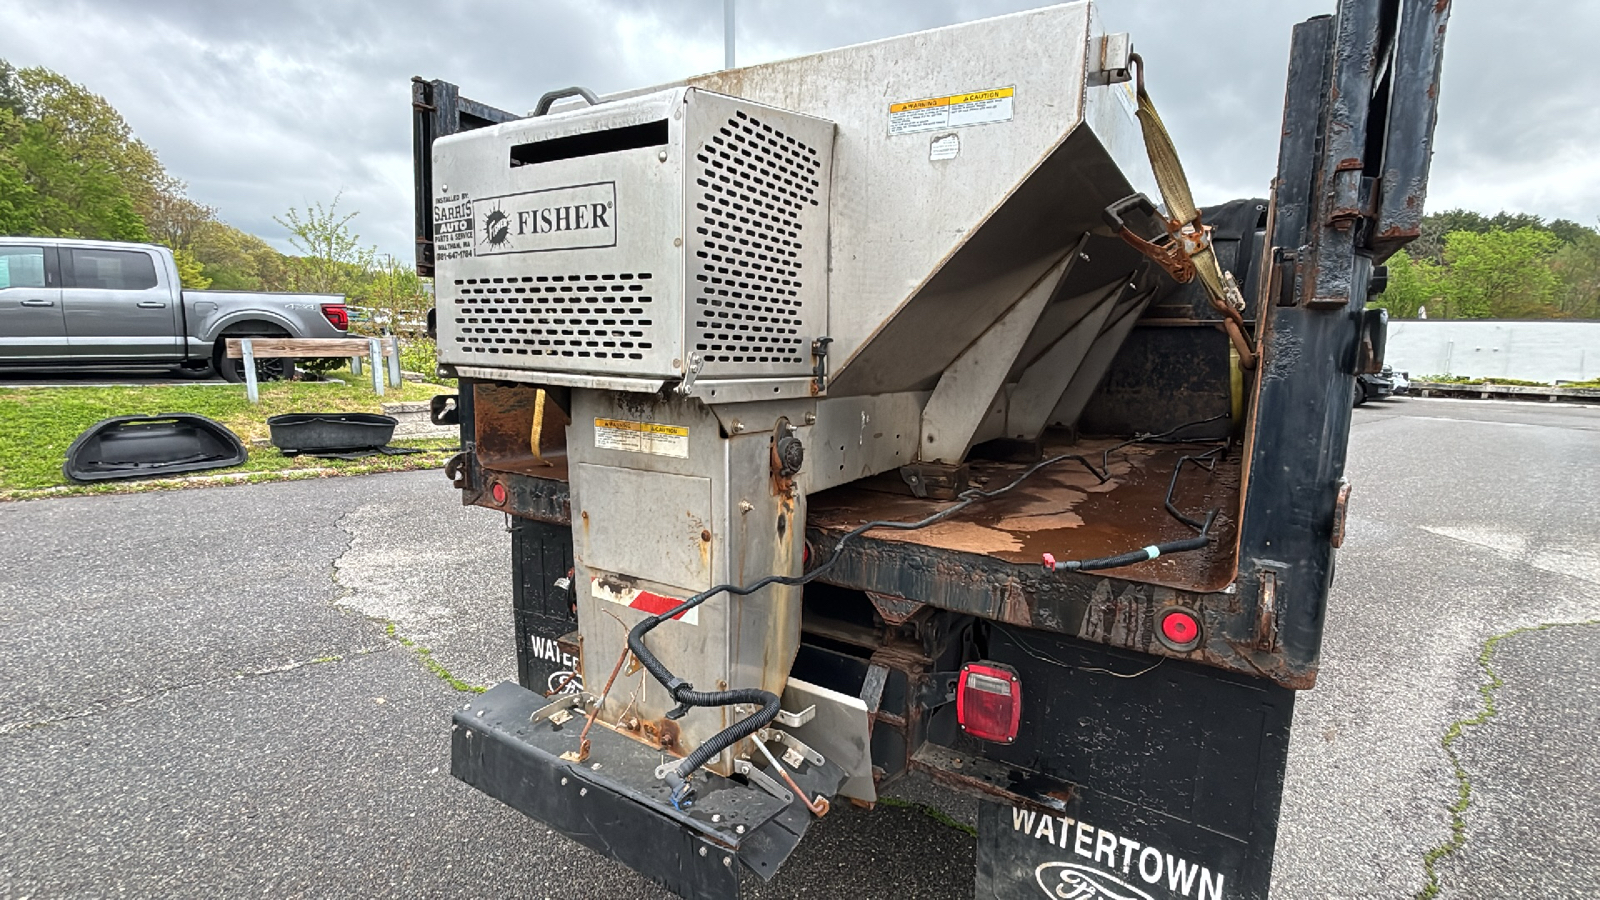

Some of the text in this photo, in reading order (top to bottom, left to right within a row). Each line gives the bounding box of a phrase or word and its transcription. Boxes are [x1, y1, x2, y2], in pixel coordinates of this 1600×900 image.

[969, 92, 999, 101] CAUTION
[907, 100, 937, 110] WARNING
[436, 195, 460, 204] INSTALLED
[434, 200, 472, 222] SARRIS
[440, 221, 468, 234] AUTO
[435, 235, 449, 243] PARTS
[455, 231, 473, 240] SERVICE
[1012, 806, 1225, 900] WATERTOWN
